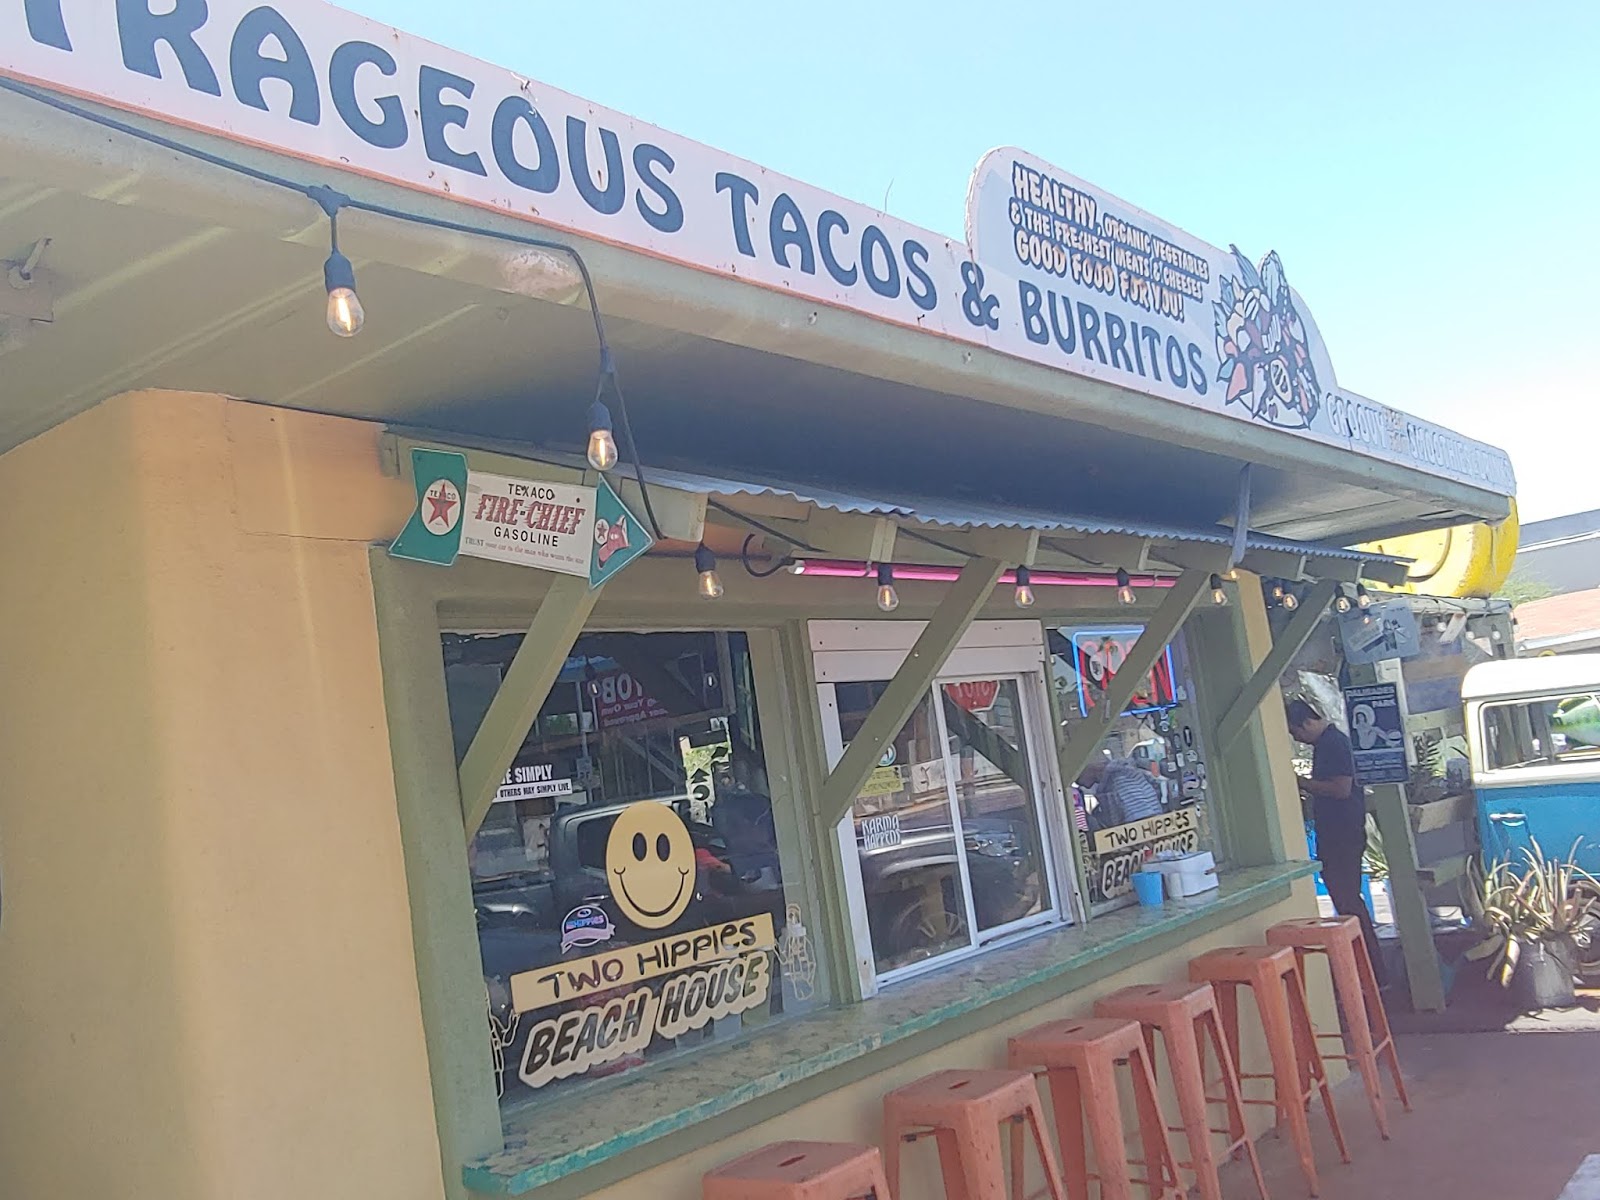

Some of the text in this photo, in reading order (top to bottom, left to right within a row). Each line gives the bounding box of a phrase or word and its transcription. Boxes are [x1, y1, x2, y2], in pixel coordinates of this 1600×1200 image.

[1024, 205, 1051, 238] THE
[1053, 220, 1112, 260] FRESHEST
[1113, 247, 1150, 278] MEATS
[1162, 265, 1203, 302] CHEESES
[1102, 213, 1150, 252] ORGANIC
[1150, 234, 1209, 283] VEGETABLES
[715, 172, 938, 312] TACOS
[961, 261, 1000, 331] &
[1018, 280, 1209, 397] BURRITOS
[1014, 229, 1185, 322] GOOD FOOD FOR YOU!
[430, 489, 457, 501] TECO
[508, 483, 556, 501] TEXACO
[476, 494, 586, 536] FIRE-CHIEF
[493, 526, 560, 548] GASOLINE
[514, 764, 553, 783] SIMPLY
[500, 788, 522, 798] OTHERS
[523, 786, 535, 796] MAY
[536, 784, 556, 794] SIMPLY
[861, 814, 900, 836] KARMA
[863, 829, 901, 850] HAPPENS
[1104, 827, 1138, 848] TWO
[537, 957, 625, 999] TWO
[522, 954, 766, 1078] BEACH HOUSE
